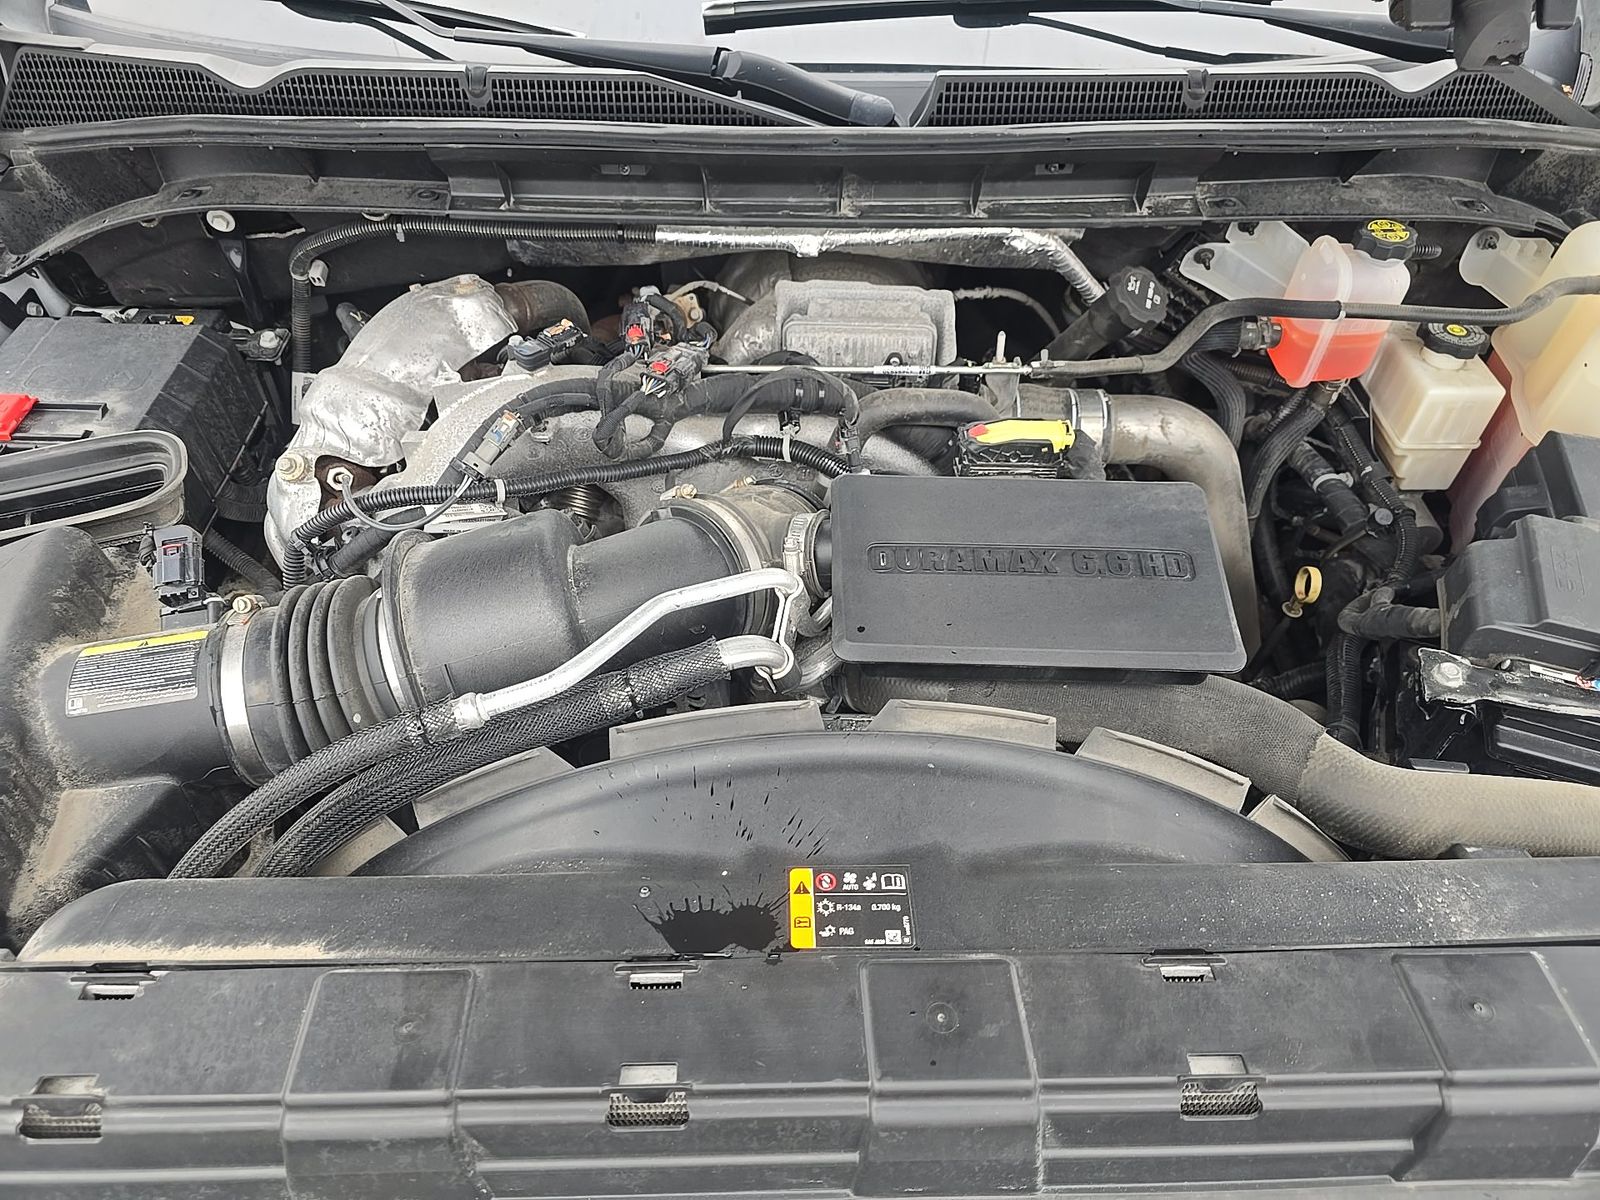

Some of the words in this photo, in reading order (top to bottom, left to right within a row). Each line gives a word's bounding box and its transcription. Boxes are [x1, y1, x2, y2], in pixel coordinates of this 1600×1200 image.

[868, 547, 1058, 574] DURAMAX
[1072, 550, 1133, 576] 6.6
[1138, 552, 1194, 579] HD
[836, 903, 861, 911] R-134a
[891, 902, 901, 912] kg
[839, 927, 855, 936] PAG
